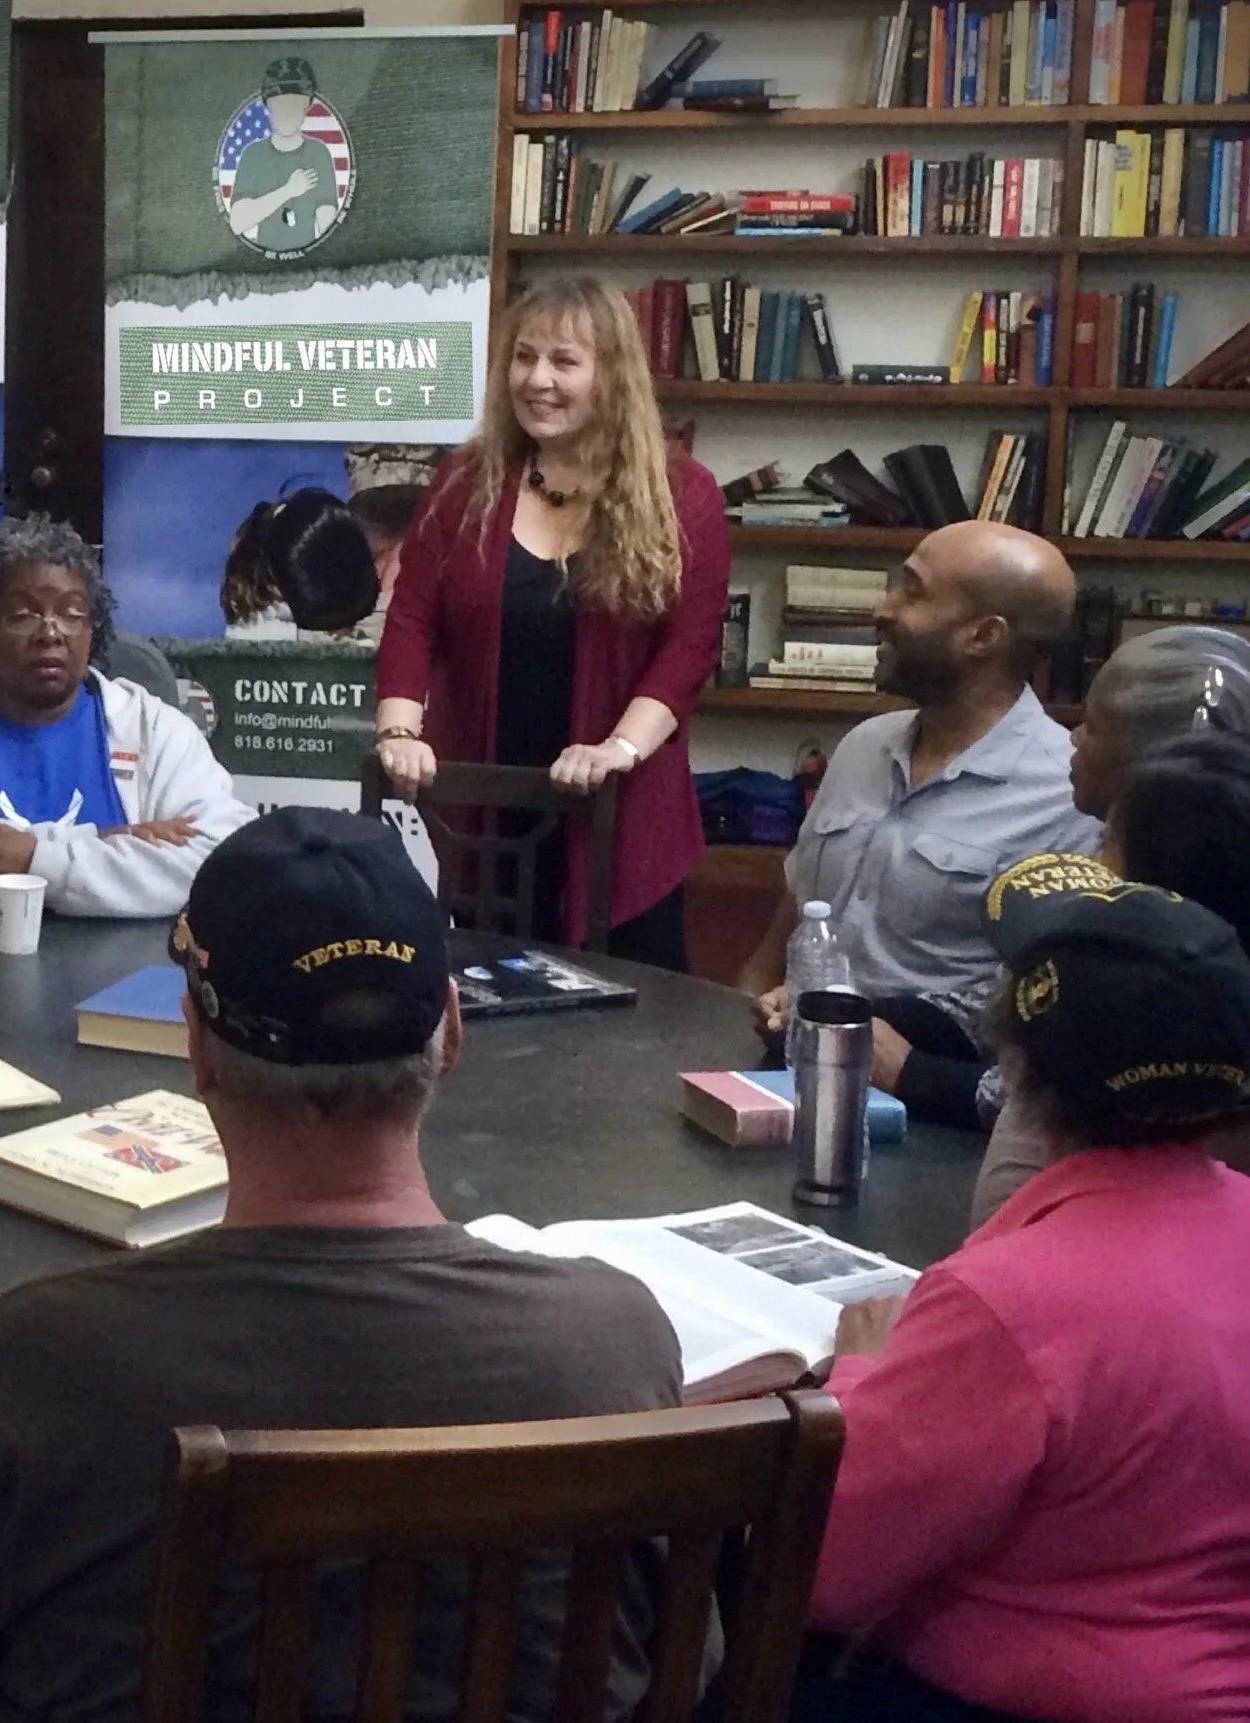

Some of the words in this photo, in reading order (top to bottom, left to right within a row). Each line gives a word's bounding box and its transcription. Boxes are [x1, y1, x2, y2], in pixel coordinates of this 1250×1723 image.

[151, 340, 291, 373] MINDFUL
[297, 338, 437, 370] VETERAN
[154, 385, 435, 410] PROJECT
[234, 679, 366, 707] CONTACT
[292, 939, 416, 973] VETERAN
[1105, 1062, 1188, 1092] WOMAN
